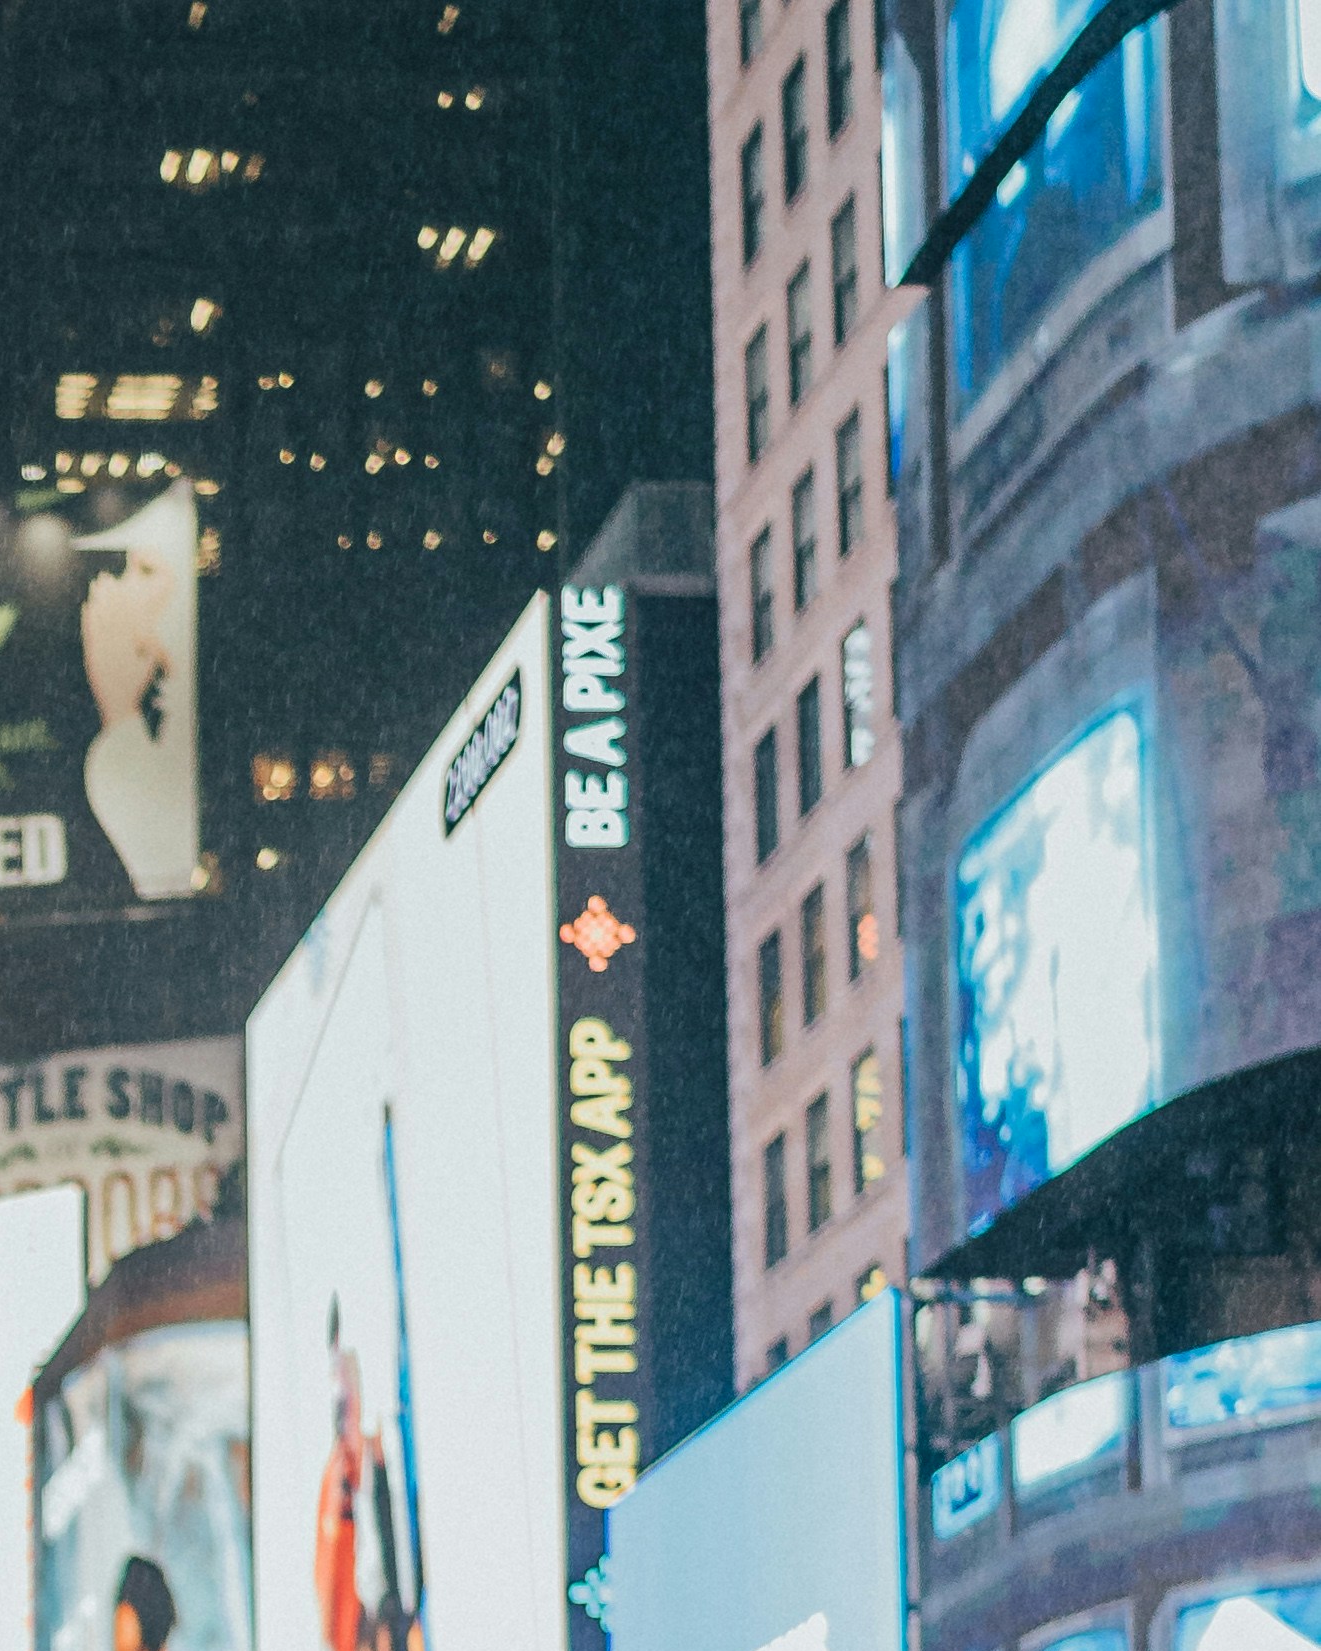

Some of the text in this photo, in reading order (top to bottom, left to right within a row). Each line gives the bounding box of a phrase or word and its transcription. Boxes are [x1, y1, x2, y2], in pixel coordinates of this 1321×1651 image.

[563, 716, 628, 767] A
[565, 767, 632, 849] BE
[105, 1064, 230, 1144] SHOP
[568, 1015, 640, 1510] GET THE TSX APP
